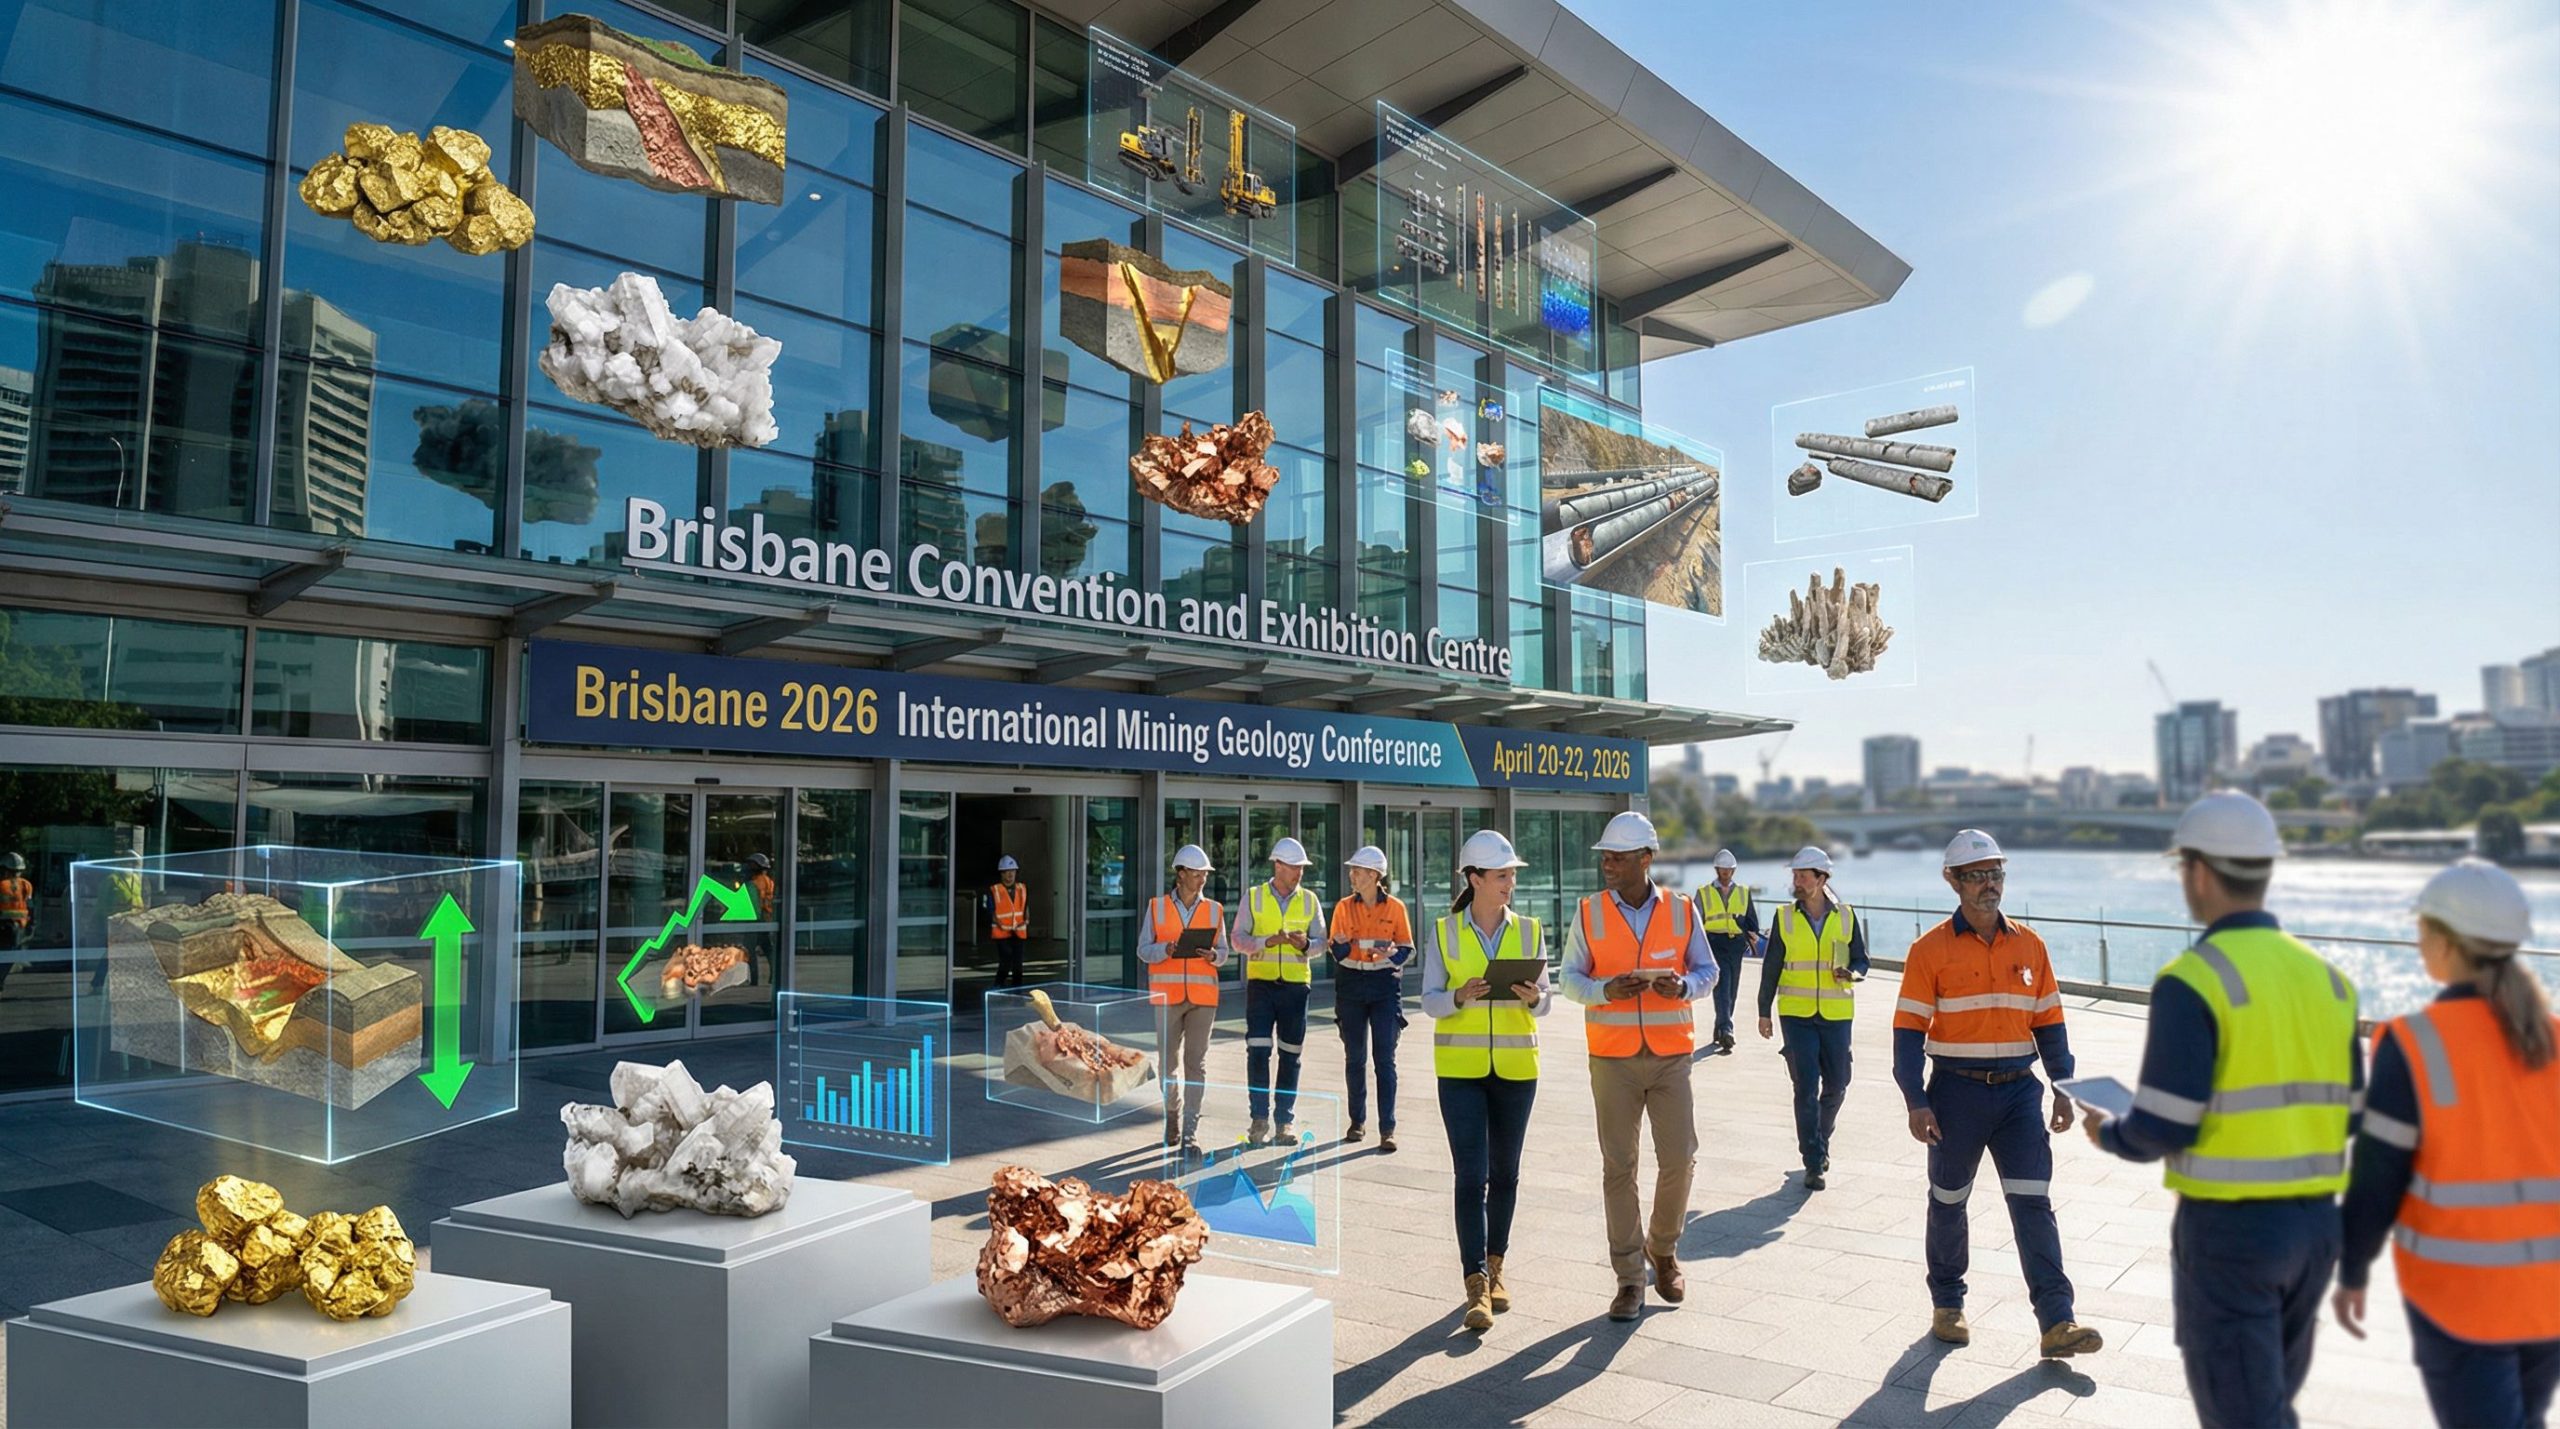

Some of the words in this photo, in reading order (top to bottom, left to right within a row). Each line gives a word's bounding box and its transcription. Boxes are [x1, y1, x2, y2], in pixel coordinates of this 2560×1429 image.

[627, 496, 891, 592] Brisbane
[908, 543, 1167, 630] Convention
[1180, 594, 1248, 641] and
[1260, 599, 1417, 664] Exhibition
[1426, 626, 1512, 677] Centre
[576, 666, 768, 729] Brisbane
[780, 682, 878, 735] 2026
[898, 690, 1106, 750] International
[1117, 708, 1209, 762] Mining
[1217, 715, 1314, 769] Geology
[1321, 725, 1442, 769] Conference
[1493, 740, 1534, 781] April
[1537, 744, 1589, 782] 20-22,
[1592, 747, 1630, 781] 2026
